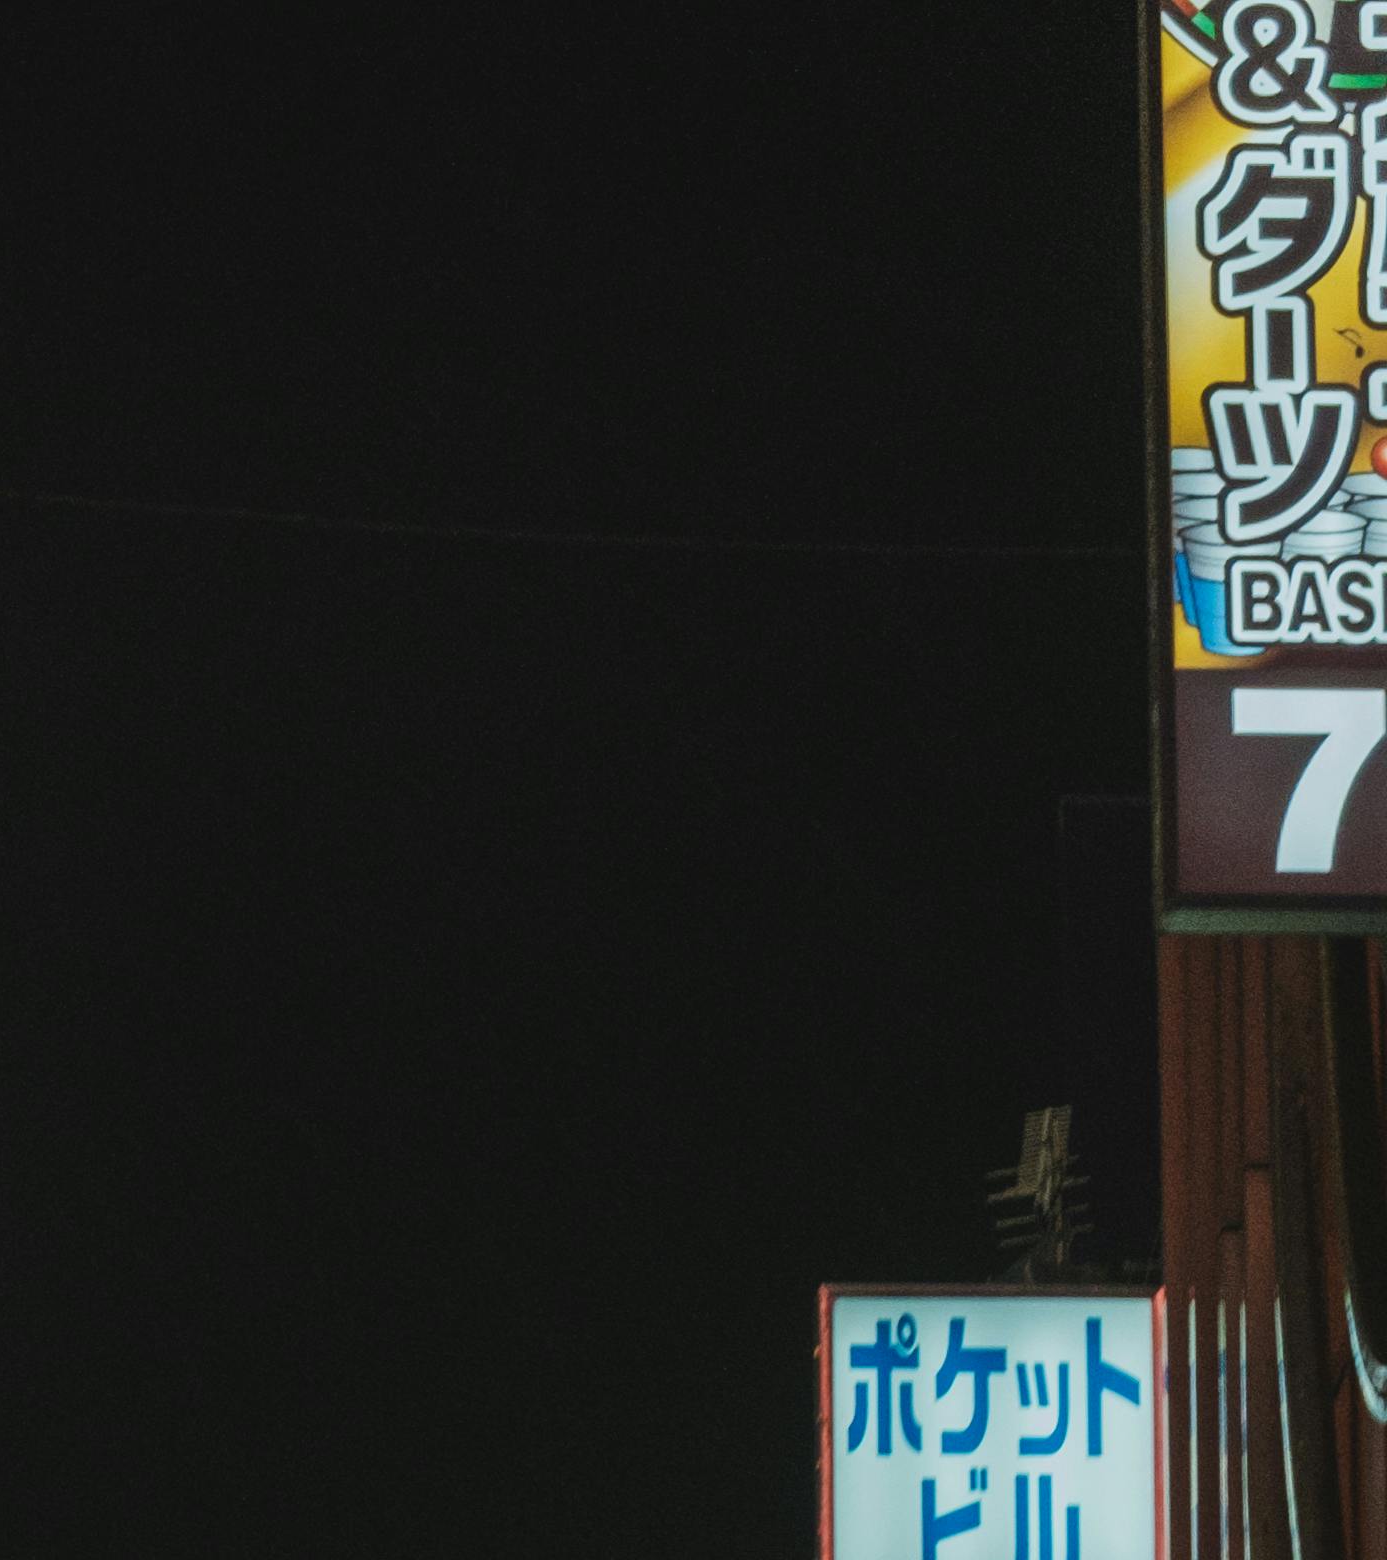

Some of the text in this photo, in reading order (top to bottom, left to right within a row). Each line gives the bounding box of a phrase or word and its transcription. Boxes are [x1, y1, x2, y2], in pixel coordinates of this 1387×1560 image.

[1225, 555, 1387, 647] BAS
[1232, 688, 1387, 874] 7
[847, 1310, 1142, 1458] ポケット
